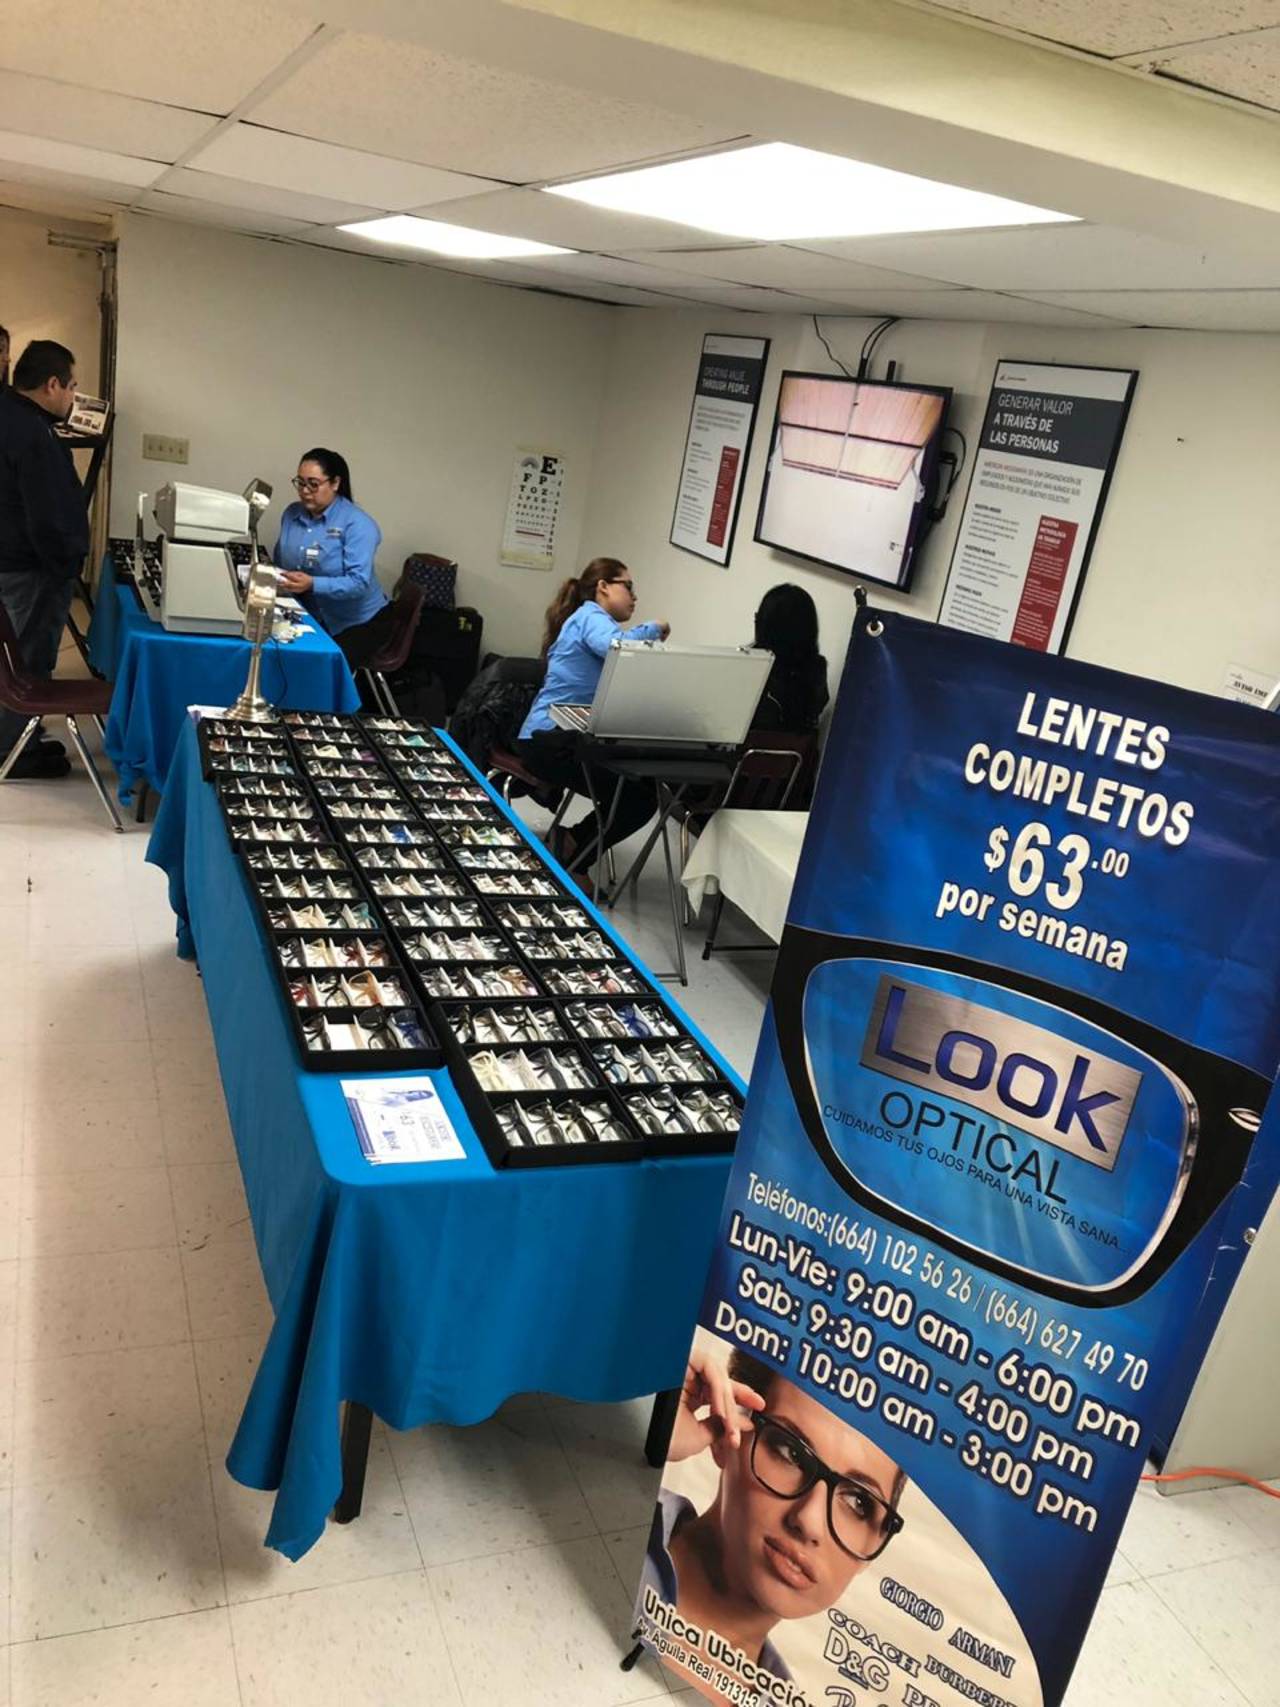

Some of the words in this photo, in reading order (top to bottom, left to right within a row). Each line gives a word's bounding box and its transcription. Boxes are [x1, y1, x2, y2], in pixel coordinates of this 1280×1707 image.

[727, 381, 751, 395] PEOPLE
[994, 412, 1002, 426] A
[1002, 411, 1038, 431] TRAVÉS
[1038, 418, 1054, 433] DE
[997, 393, 1042, 412] GENERAR
[1043, 400, 1074, 416] VALOR
[540, 455, 558, 476] E
[990, 430, 1008, 445] LAS
[1008, 433, 1060, 454] PERSONAS
[1017, 691, 1171, 771] LENTES
[964, 743, 1194, 847] COMPLETOS
[936, 881, 995, 920] por
[999, 902, 1128, 972] semana
[875, 985, 1121, 1152] Look
[823, 1105, 894, 1143] CUIDAMOS
[898, 1134, 924, 1155] TUS
[927, 1147, 965, 1171] OJOS
[967, 1165, 1001, 1192] PARA
[1004, 1183, 1033, 1208] UNA
[1036, 1199, 1075, 1229] VISTA
[880, 1091, 1067, 1205] OPTICAL
[729, 1215, 837, 1291] Lun-Vie:
[847, 1272, 913, 1325] 9:00
[918, 1314, 970, 1361] am
[998, 1353, 1073, 1414] 6:00
[1076, 1399, 1141, 1448] pm
[882, 1235, 918, 1275] 102
[920, 1252, 945, 1289] 56
[947, 1268, 973, 1304] 26
[973, 1284, 986, 1312] /
[986, 1290, 1038, 1345] (664)
[1040, 1319, 1082, 1359] 627
[1084, 1341, 1114, 1374] 49
[1117, 1353, 1148, 1391] 70
[715, 1301, 789, 1362] Dom:
[799, 1343, 877, 1408] 10:00
[883, 1396, 935, 1441] am
[962, 1434, 1033, 1496] 3:00
[1036, 1484, 1098, 1533] pm
[738, 1267, 800, 1322] Sab:
[809, 1303, 872, 1359] 9:30
[878, 1346, 930, 1390] am
[957, 1384, 1029, 1443] 4:00
[1031, 1431, 1094, 1480] pm
[644, 1588, 701, 1647] Unica
[707, 1635, 813, 1707] Ubicació
[687, 1655, 715, 1681] Real
[824, 1626, 890, 1692] D&G
[828, 1608, 921, 1678] COACH
[880, 1577, 944, 1631] GIORGIO
[948, 1627, 1016, 1679] ARMANI
[925, 1655, 1018, 1707] BURBER
